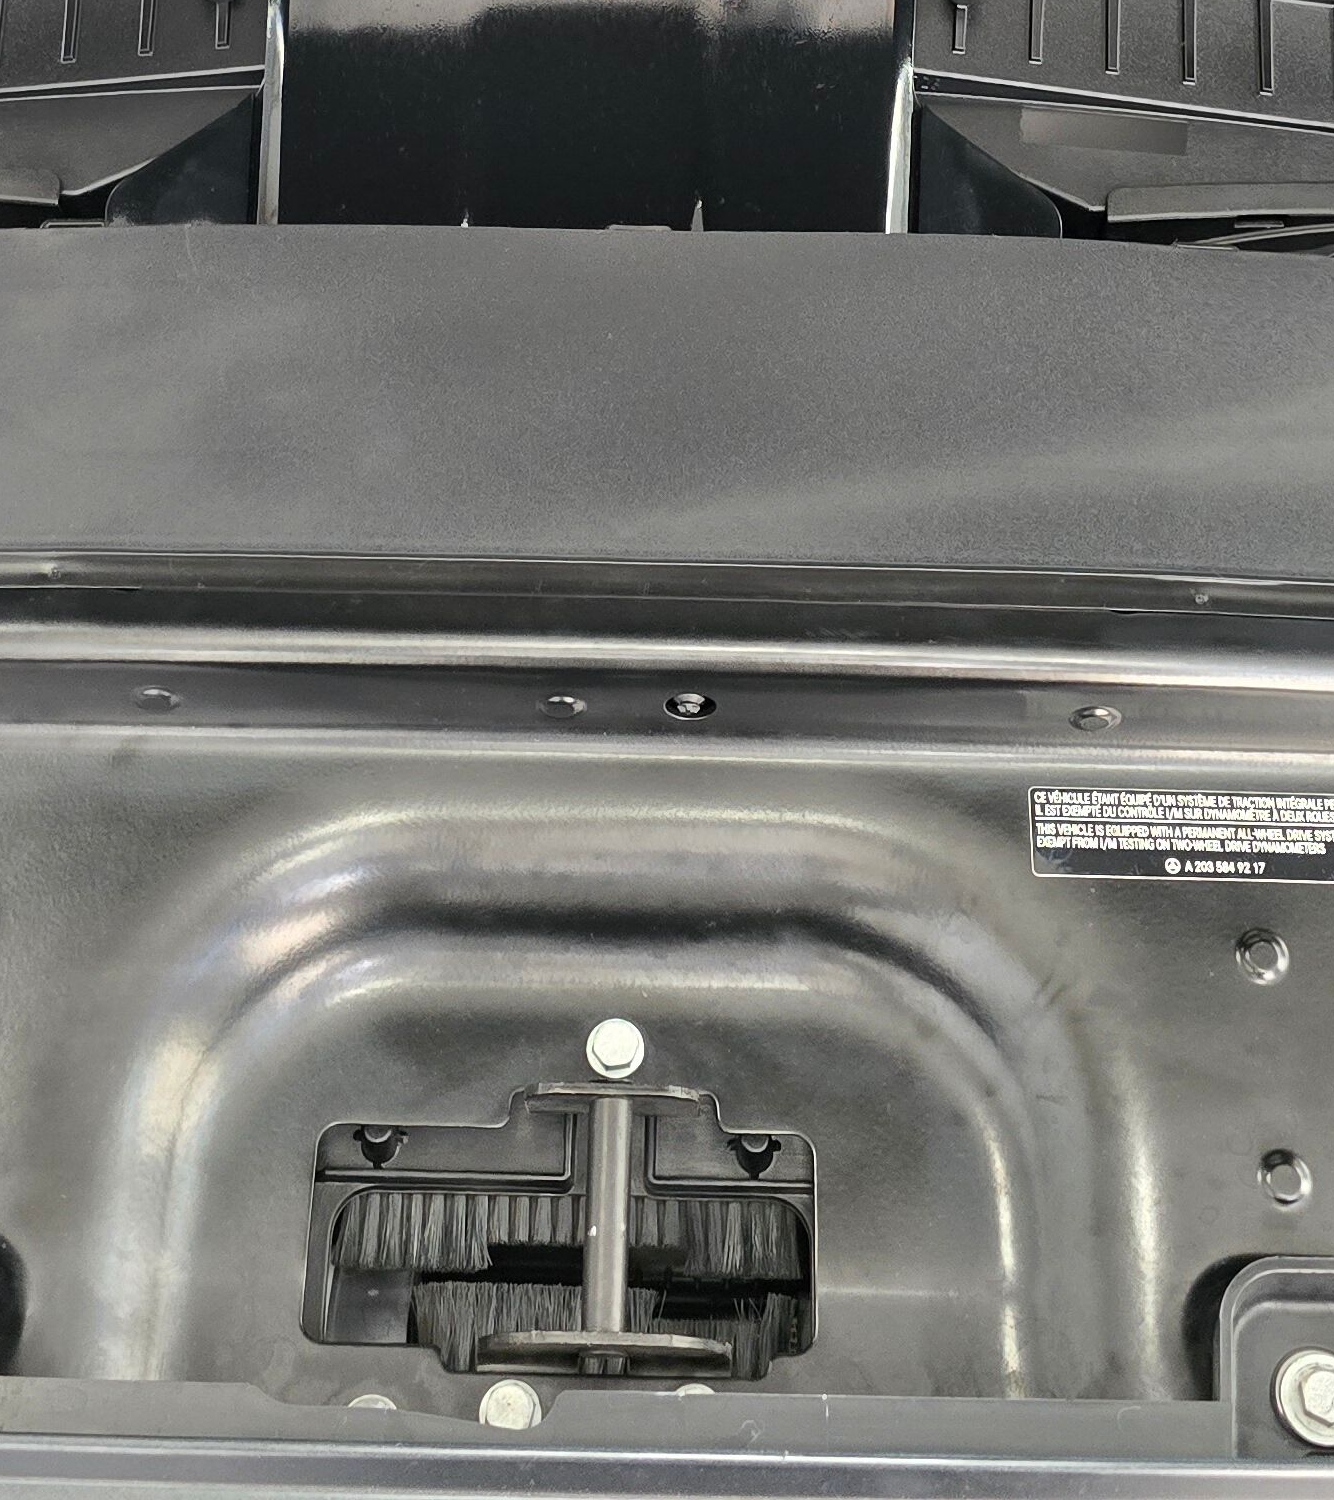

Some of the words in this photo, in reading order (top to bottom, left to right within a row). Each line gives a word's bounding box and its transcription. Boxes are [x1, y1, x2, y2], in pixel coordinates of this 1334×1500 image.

[1034, 792, 1047, 804] CE
[1048, 790, 1091, 804] VÉHICULE
[1092, 790, 1119, 804] ÉTANT
[1121, 792, 1152, 806] ÉQUIPÉ
[1153, 794, 1176, 806] D'UN
[1177, 794, 1217, 808] SYSTÈME
[1218, 796, 1231, 808] DE
[1231, 796, 1275, 809] TRACTION
[1276, 796, 1324, 810] INTÉGRALE
[1045, 806, 1061, 816] EST
[1062, 804, 1101, 818] EXEMPTÉ
[1103, 806, 1116, 817] DU
[1118, 805, 1165, 818] CONTRÔLE
[1184, 808, 1203, 820] SUR
[1204, 808, 1271, 822] DYNAMOMÈTRE
[1280, 812, 1305, 822] DEUX
[1035, 823, 1056, 834] THIS
[1057, 824, 1094, 836] VEHICLE
[1095, 825, 1105, 836] IS
[1106, 826, 1149, 838] EQUIPPED
[1150, 826, 1173, 838] WITH
[1175, 827, 1182, 838] A
[1183, 827, 1237, 840] PERMANENT
[1237, 828, 1285, 841] ALL-WHEEL
[1286, 829, 1315, 842] DRIVE
[1037, 836, 1071, 848] EXEMPT
[1072, 837, 1099, 849] FROM
[1119, 838, 1155, 850] TESTING
[1156, 840, 1169, 850] ON
[1171, 840, 1223, 852] TWO-WHEEL
[1225, 840, 1251, 852] DRIVE
[1253, 842, 1327, 854] DYNAMOMETERS
[1184, 860, 1193, 873] A
[1195, 861, 1214, 873] 203
[1215, 861, 1235, 874] 584
[1237, 862, 1251, 874] 92
[1253, 862, 1266, 874] 17
